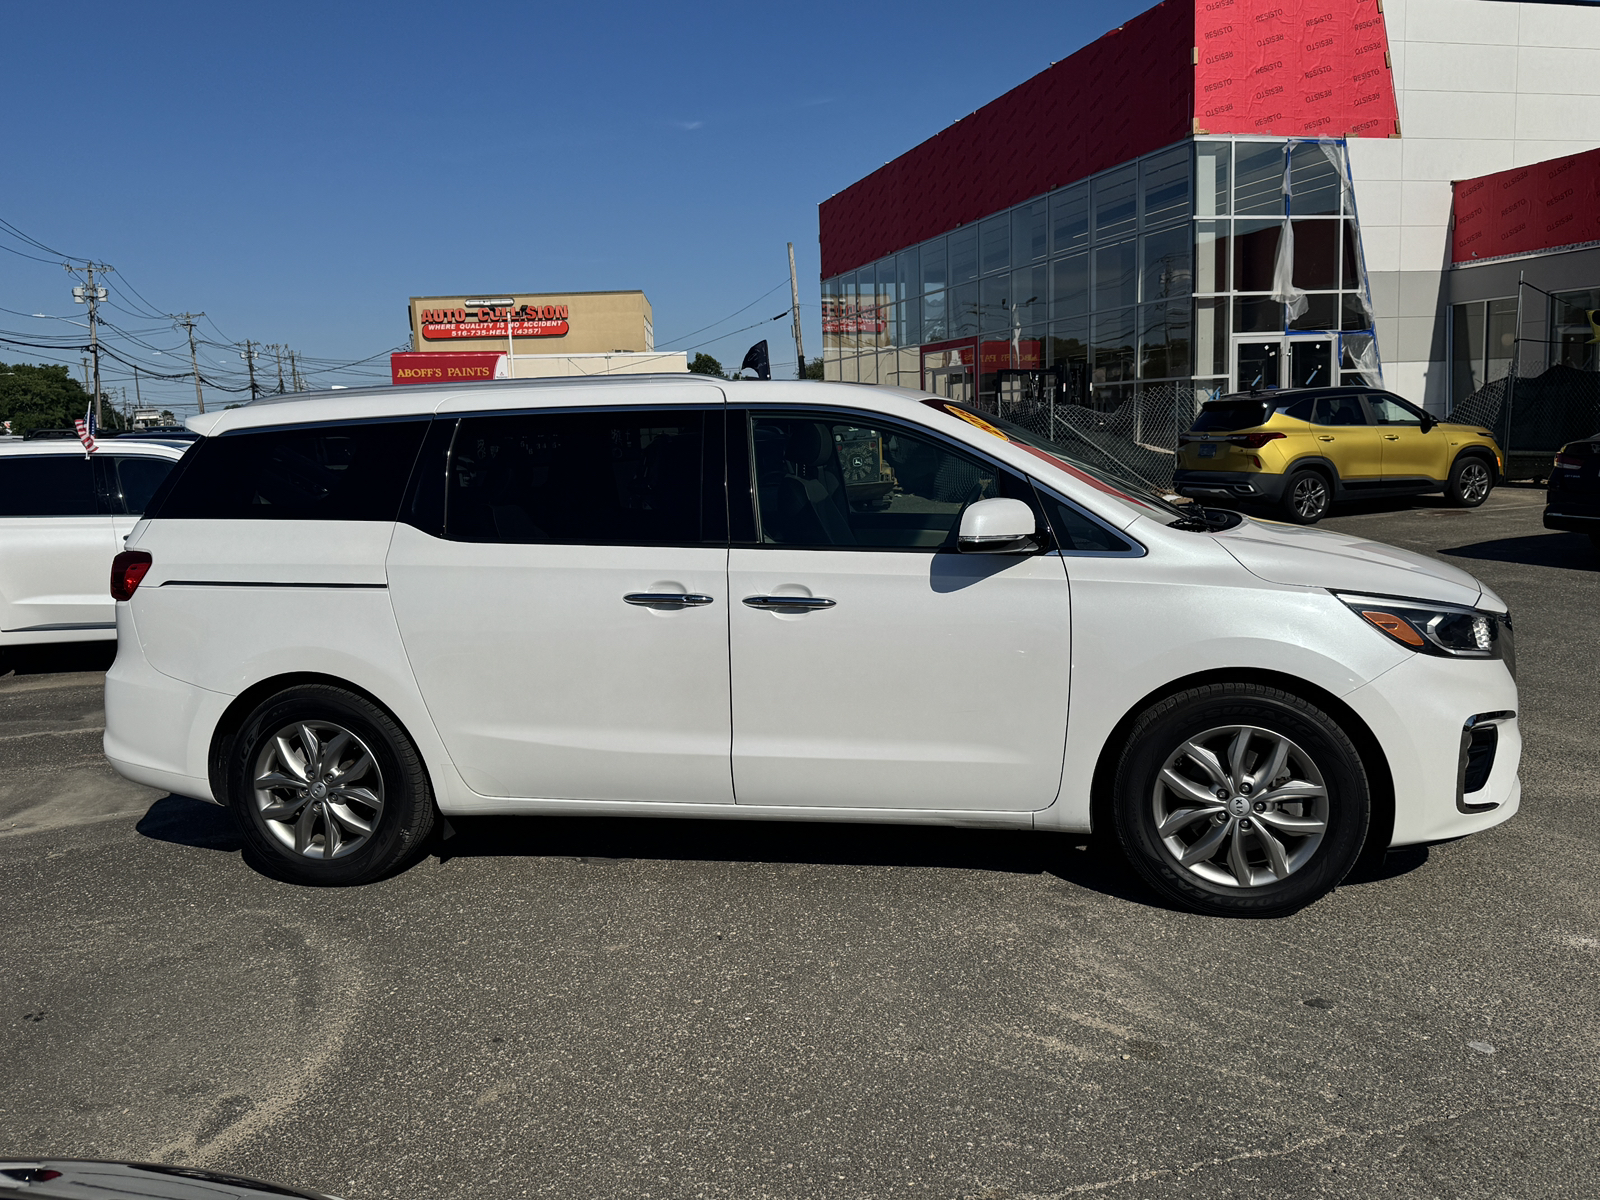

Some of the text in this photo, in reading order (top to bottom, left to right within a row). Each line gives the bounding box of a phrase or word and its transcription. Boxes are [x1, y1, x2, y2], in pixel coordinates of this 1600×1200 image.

[1305, 14, 1332, 27] RESISTO
[1355, 18, 1381, 31] RESISTO
[1205, 26, 1232, 40] RESISTO
[1256, 34, 1284, 47] RESISTO
[1306, 38, 1333, 52] RESISTO
[1355, 42, 1382, 55] RESISTO
[1206, 51, 1234, 65] RESISTO
[1256, 61, 1282, 75] RESISTO
[1305, 65, 1332, 79] RESISTO
[1353, 69, 1380, 82] RESISTO
[1204, 78, 1232, 93] RESISTO
[1256, 85, 1284, 99] RESISTO
[1305, 90, 1332, 104] RESISTO
[1354, 93, 1380, 106] RESISTO
[1205, 103, 1233, 117] RESISTO
[1254, 113, 1282, 127] RESISTO
[1304, 116, 1331, 131] RESISTO
[1352, 119, 1378, 133] RESISTO
[1549, 158, 1576, 179] RESISTO
[1503, 170, 1528, 190] RESISTO
[1461, 181, 1484, 199] RESISTO
[1501, 199, 1527, 217] RESISTO
[1459, 207, 1482, 225] RESISTO
[1501, 223, 1526, 240] RESISTO
[1459, 231, 1482, 247] RESISTO
[422, 308, 466, 323] AUTO
[523, 320, 563, 328] ACCIDENT
[397, 367, 490, 378] ABOFF'S PAINTS
[1235, 799, 1244, 815] KIA
